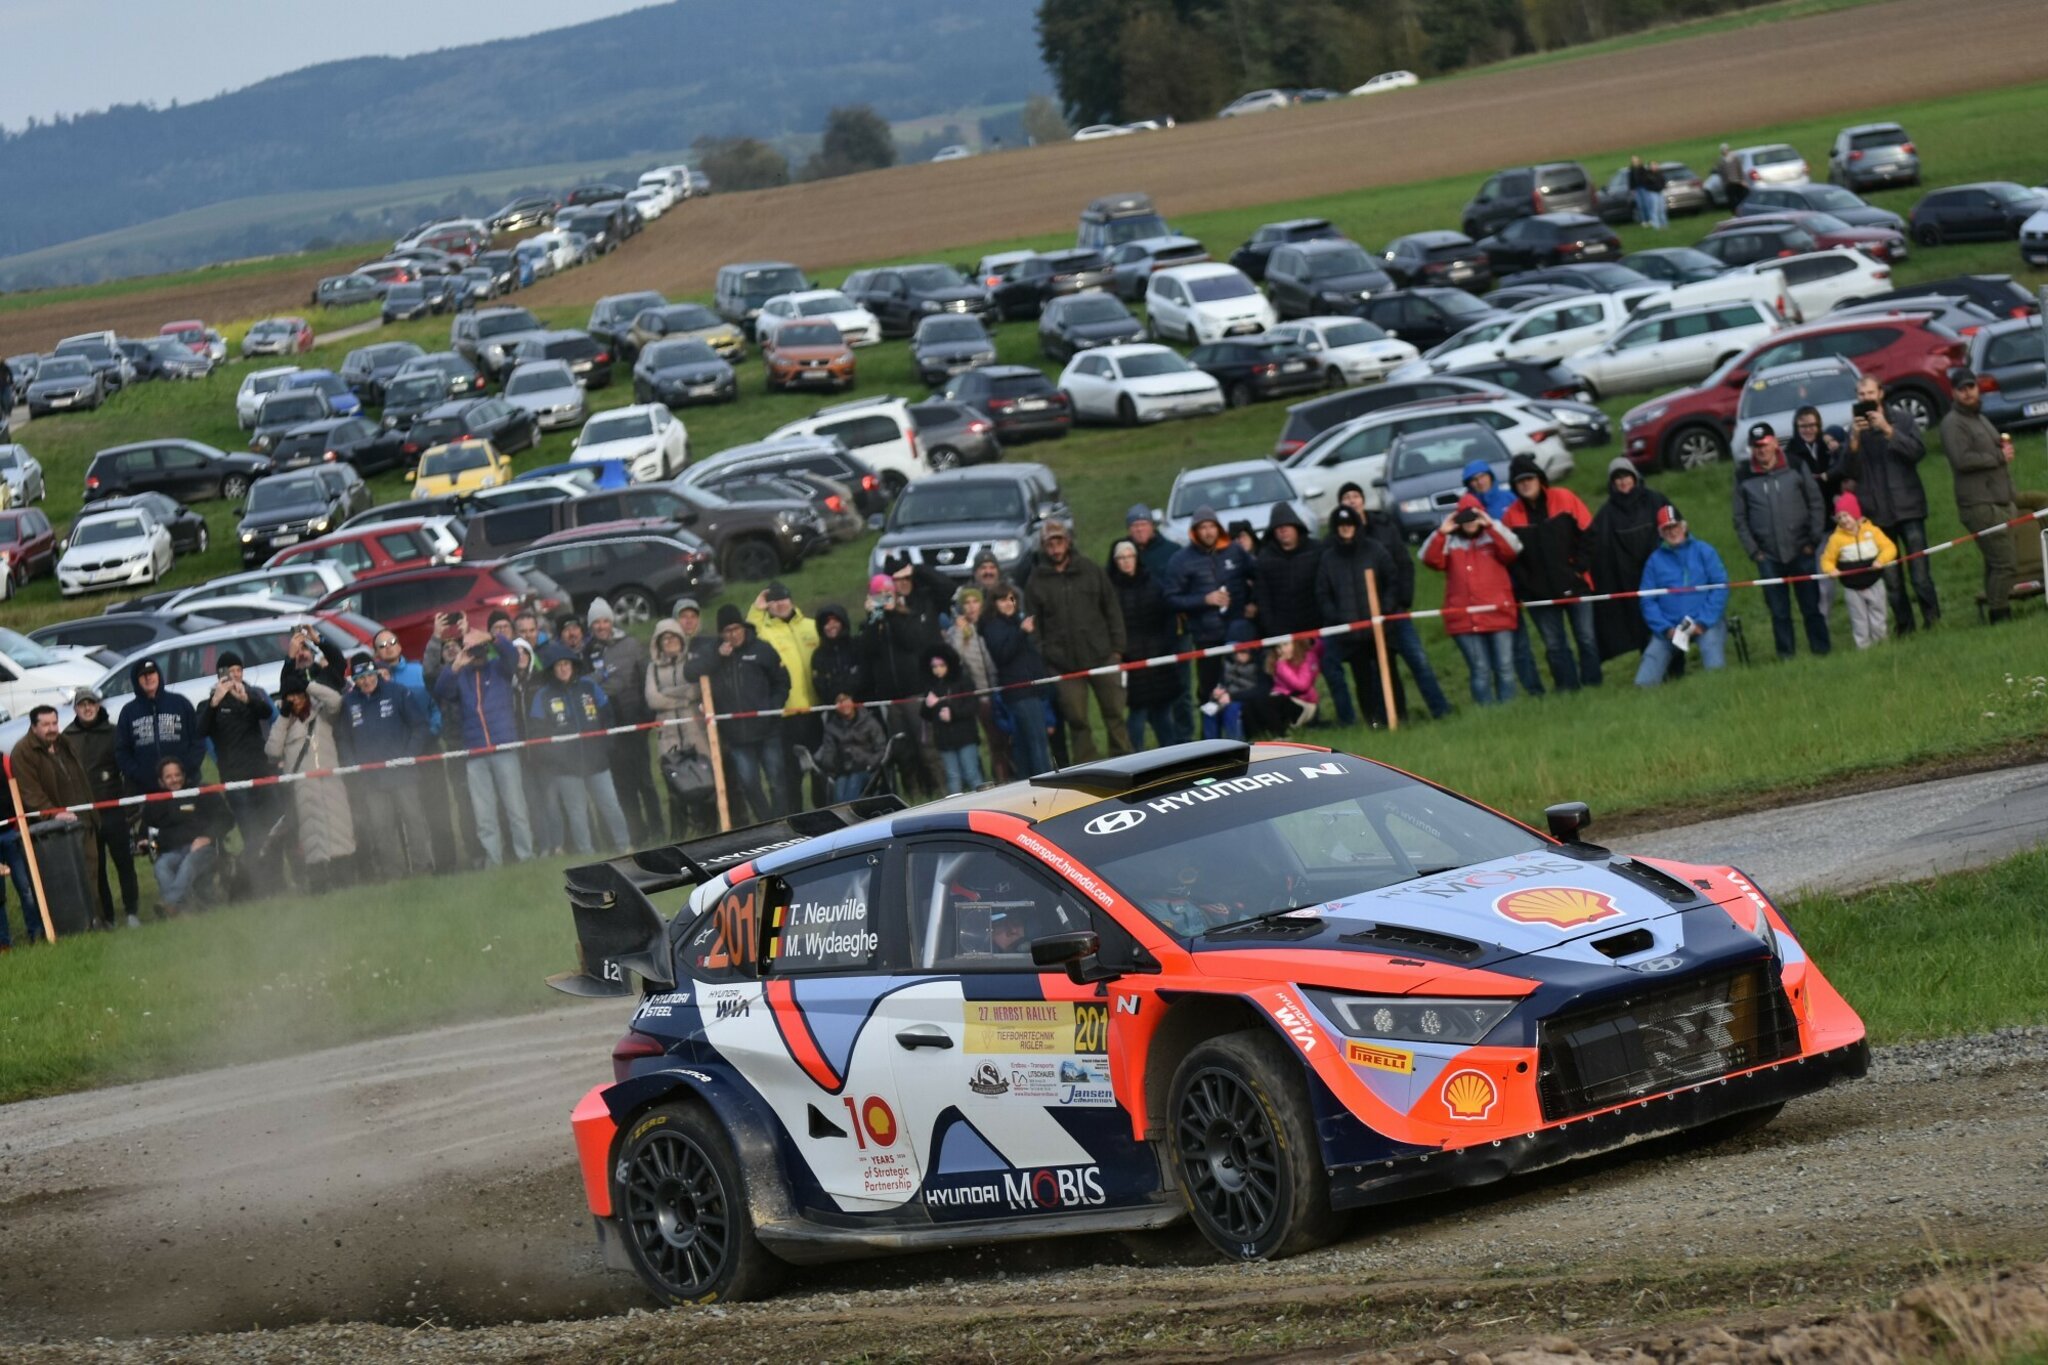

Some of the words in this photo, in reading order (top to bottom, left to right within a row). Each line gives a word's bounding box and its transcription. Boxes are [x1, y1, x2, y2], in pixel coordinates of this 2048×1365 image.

[1147, 771, 1293, 814] HYUNDAI
[1017, 833, 1114, 907] motorsport.hyundai.com
[1417, 861, 1584, 899] MOBIS
[790, 903, 801, 927] T.
[804, 898, 867, 925] Neuville
[707, 893, 757, 969] 201
[785, 935, 801, 958] M.
[806, 928, 879, 961] Wydaeghe
[652, 992, 690, 1005] HYUNDAI
[708, 989, 740, 998] HYUNDAI
[646, 1006, 672, 1017] STEEL
[993, 1006, 1024, 1022] HERBST
[1026, 1006, 1058, 1022] RALLYE
[1275, 992, 1313, 1027] HYUNDAI
[997, 1031, 1055, 1041] TIEFBOHRTECHNIK
[1075, 1006, 1109, 1052] 201
[1020, 1040, 1045, 1050] RIGLER
[1350, 1045, 1407, 1070] PIRELLI
[1059, 1085, 1113, 1105] Jansen
[634, 1115, 669, 1139] ZERO
[864, 1166, 873, 1179] of
[873, 1164, 910, 1179] Strategic
[871, 1154, 895, 1165] YEARS
[864, 1177, 913, 1192] Partnership
[926, 1184, 1000, 1207] HYUNDAI
[1003, 1166, 1106, 1210] MOBIS
